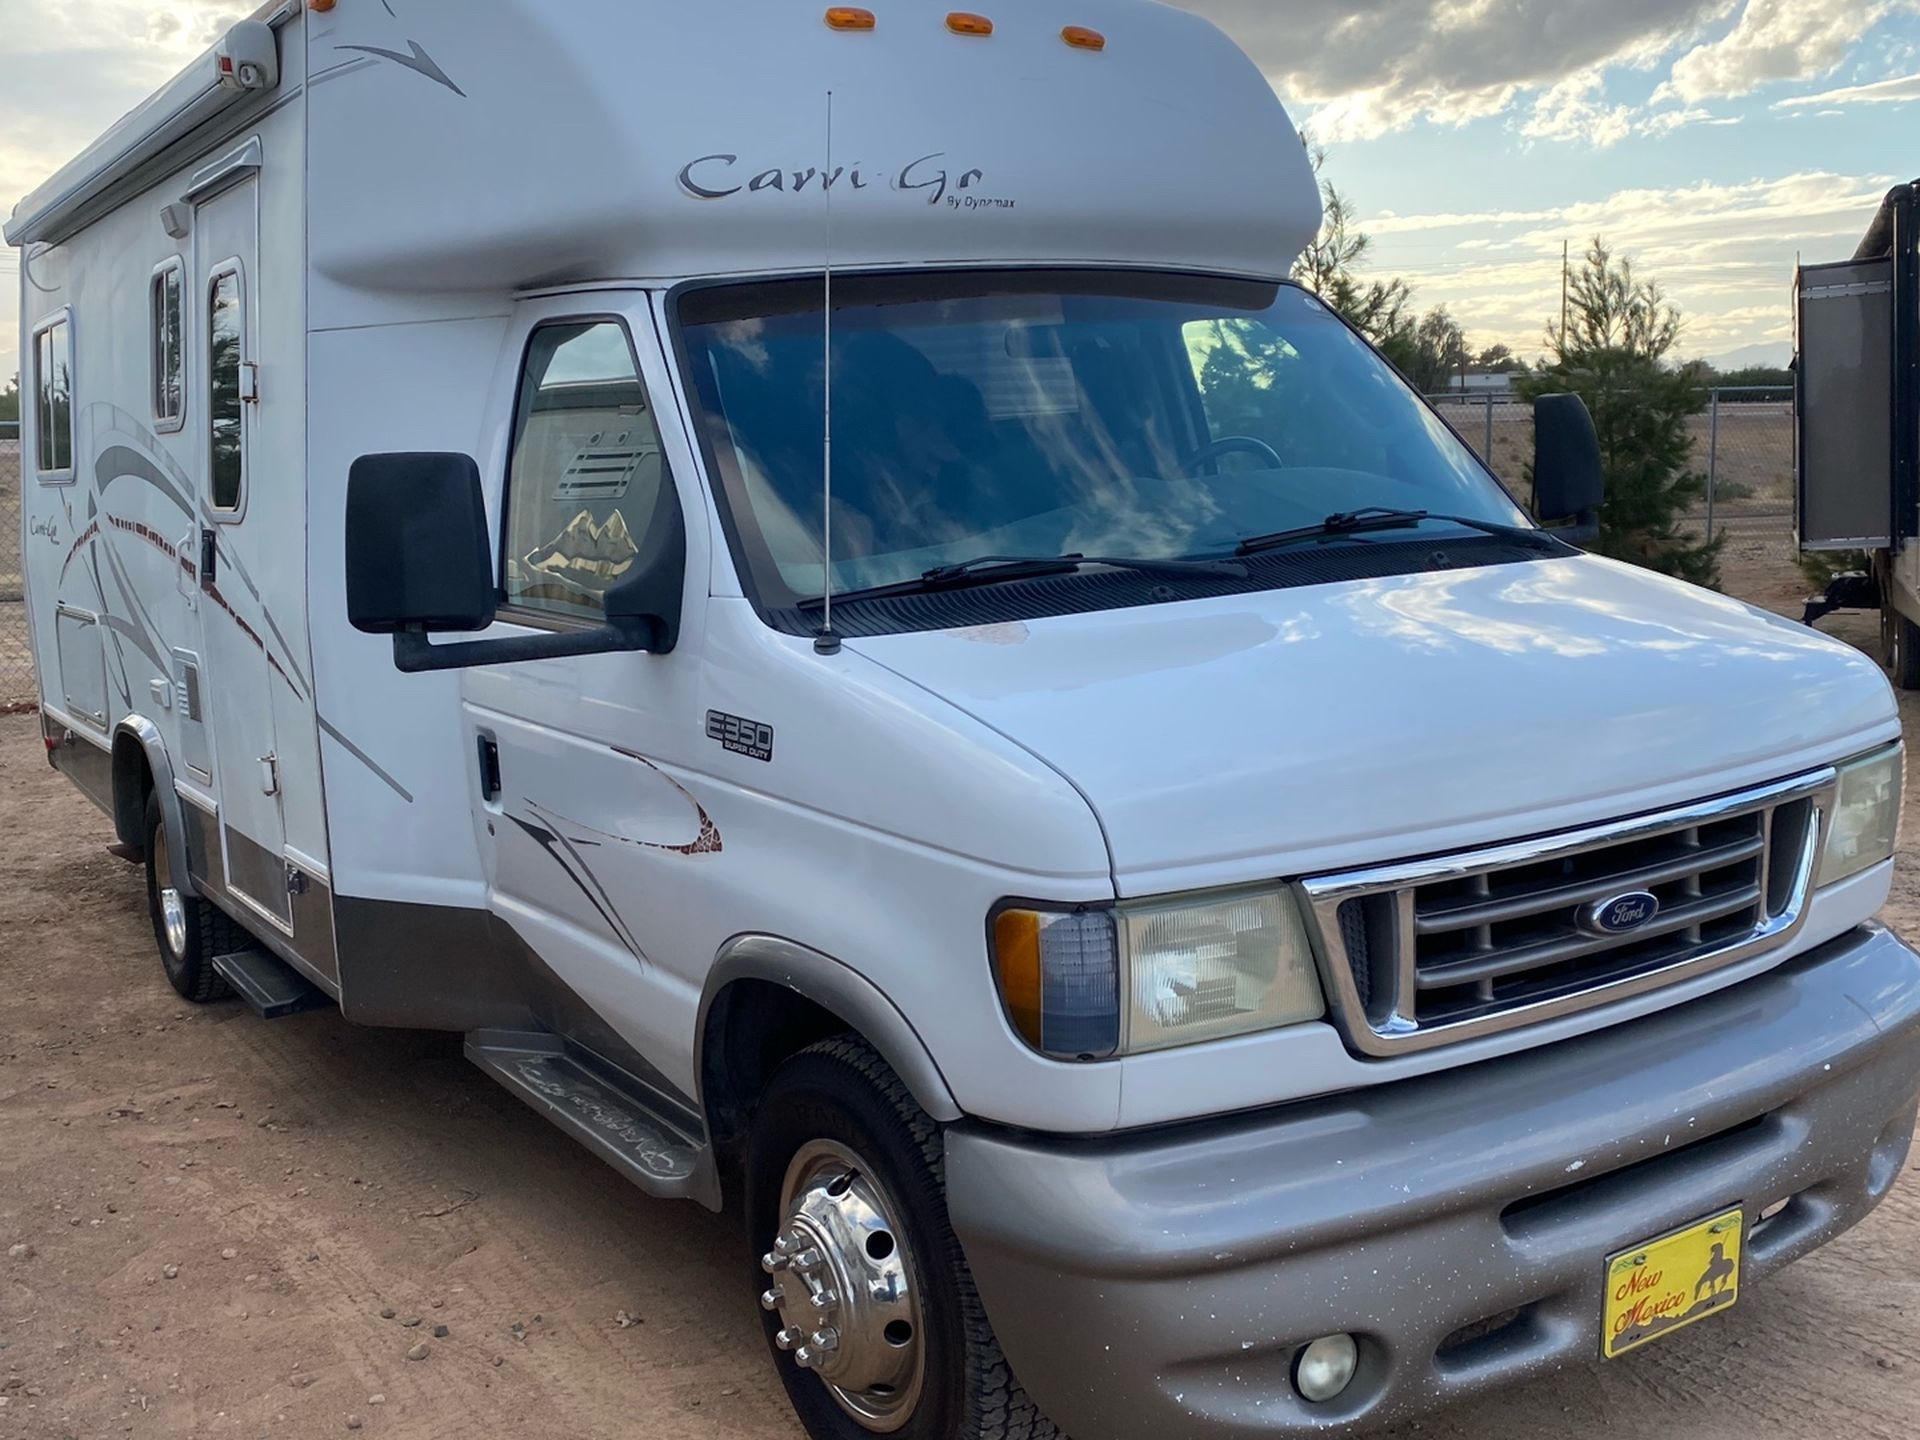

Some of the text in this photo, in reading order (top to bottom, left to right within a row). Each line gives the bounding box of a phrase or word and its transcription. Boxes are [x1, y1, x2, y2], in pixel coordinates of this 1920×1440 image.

[947, 195, 961, 209] By
[724, 740, 769, 759] SUPER DUTY
[1612, 900, 1645, 925] Ford
[1616, 1266, 1663, 1301] New
[1614, 1292, 1686, 1333] Mexico
